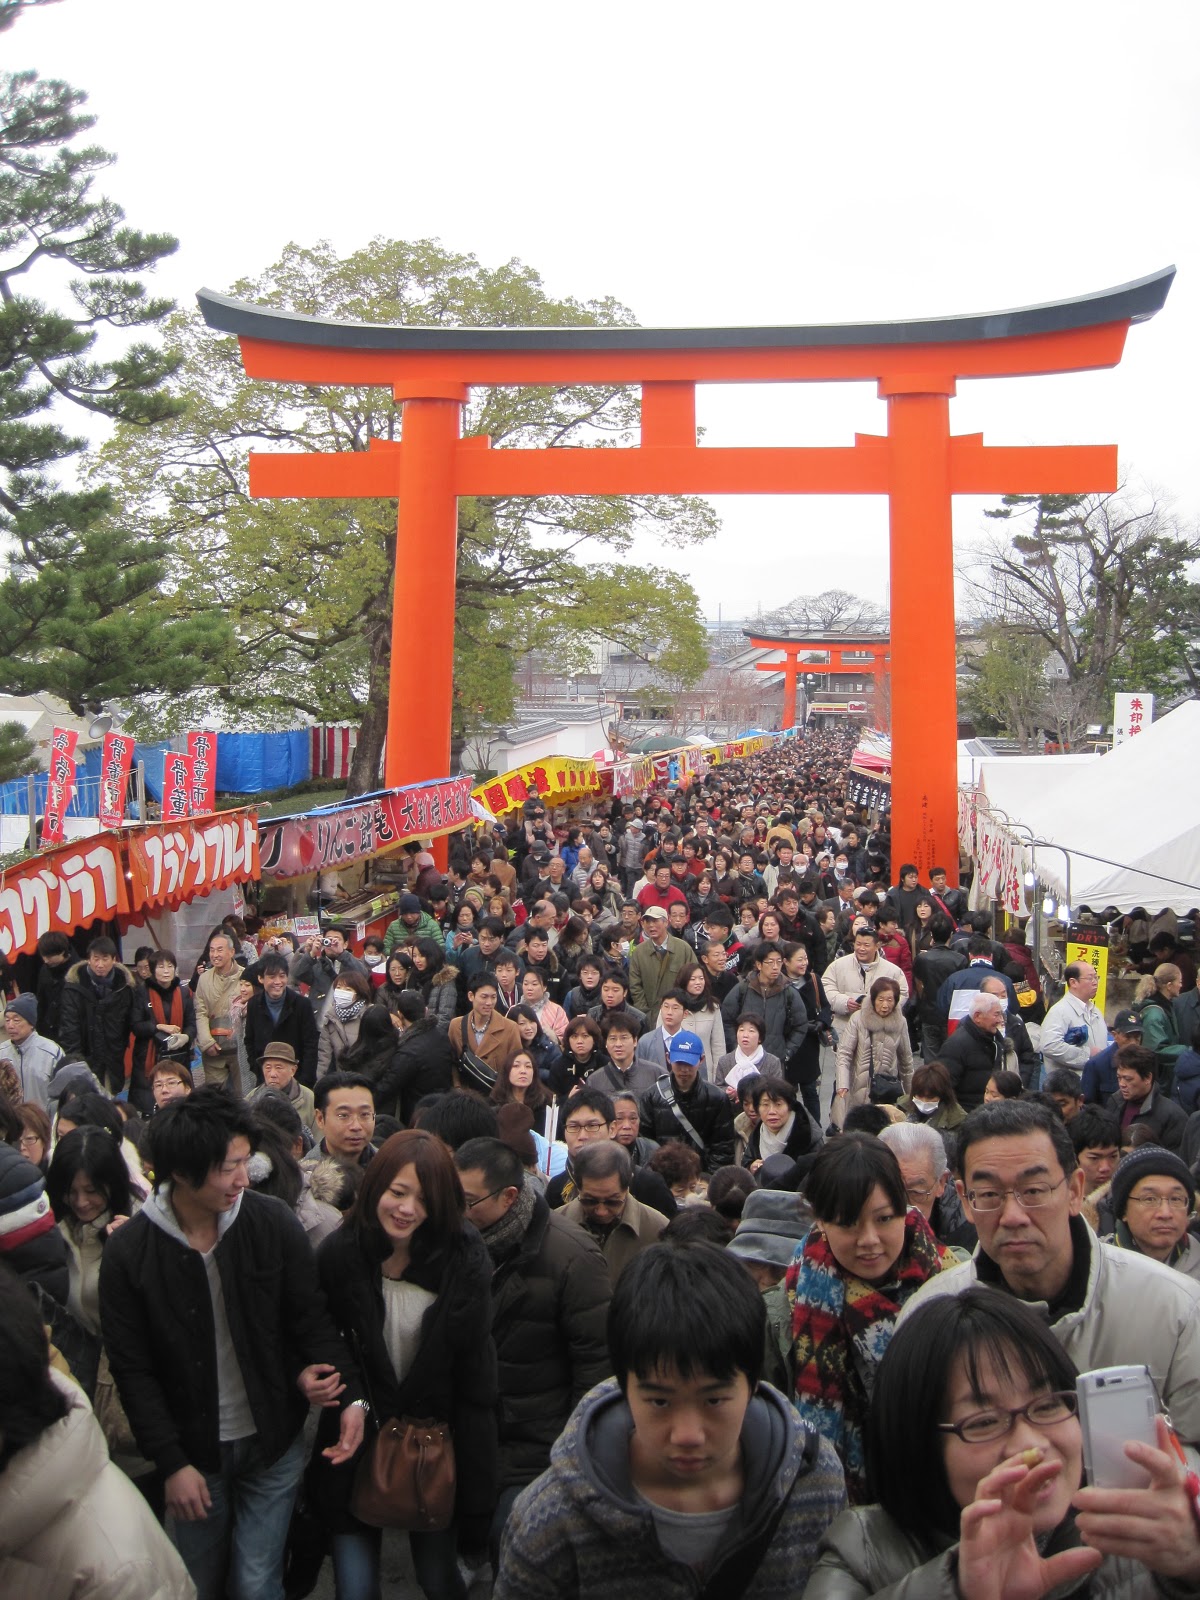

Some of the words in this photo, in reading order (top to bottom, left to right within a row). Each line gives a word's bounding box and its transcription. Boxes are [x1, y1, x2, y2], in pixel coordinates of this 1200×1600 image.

[144, 819, 258, 895] フランクフルト
[317, 811, 375, 864] りんご飴
